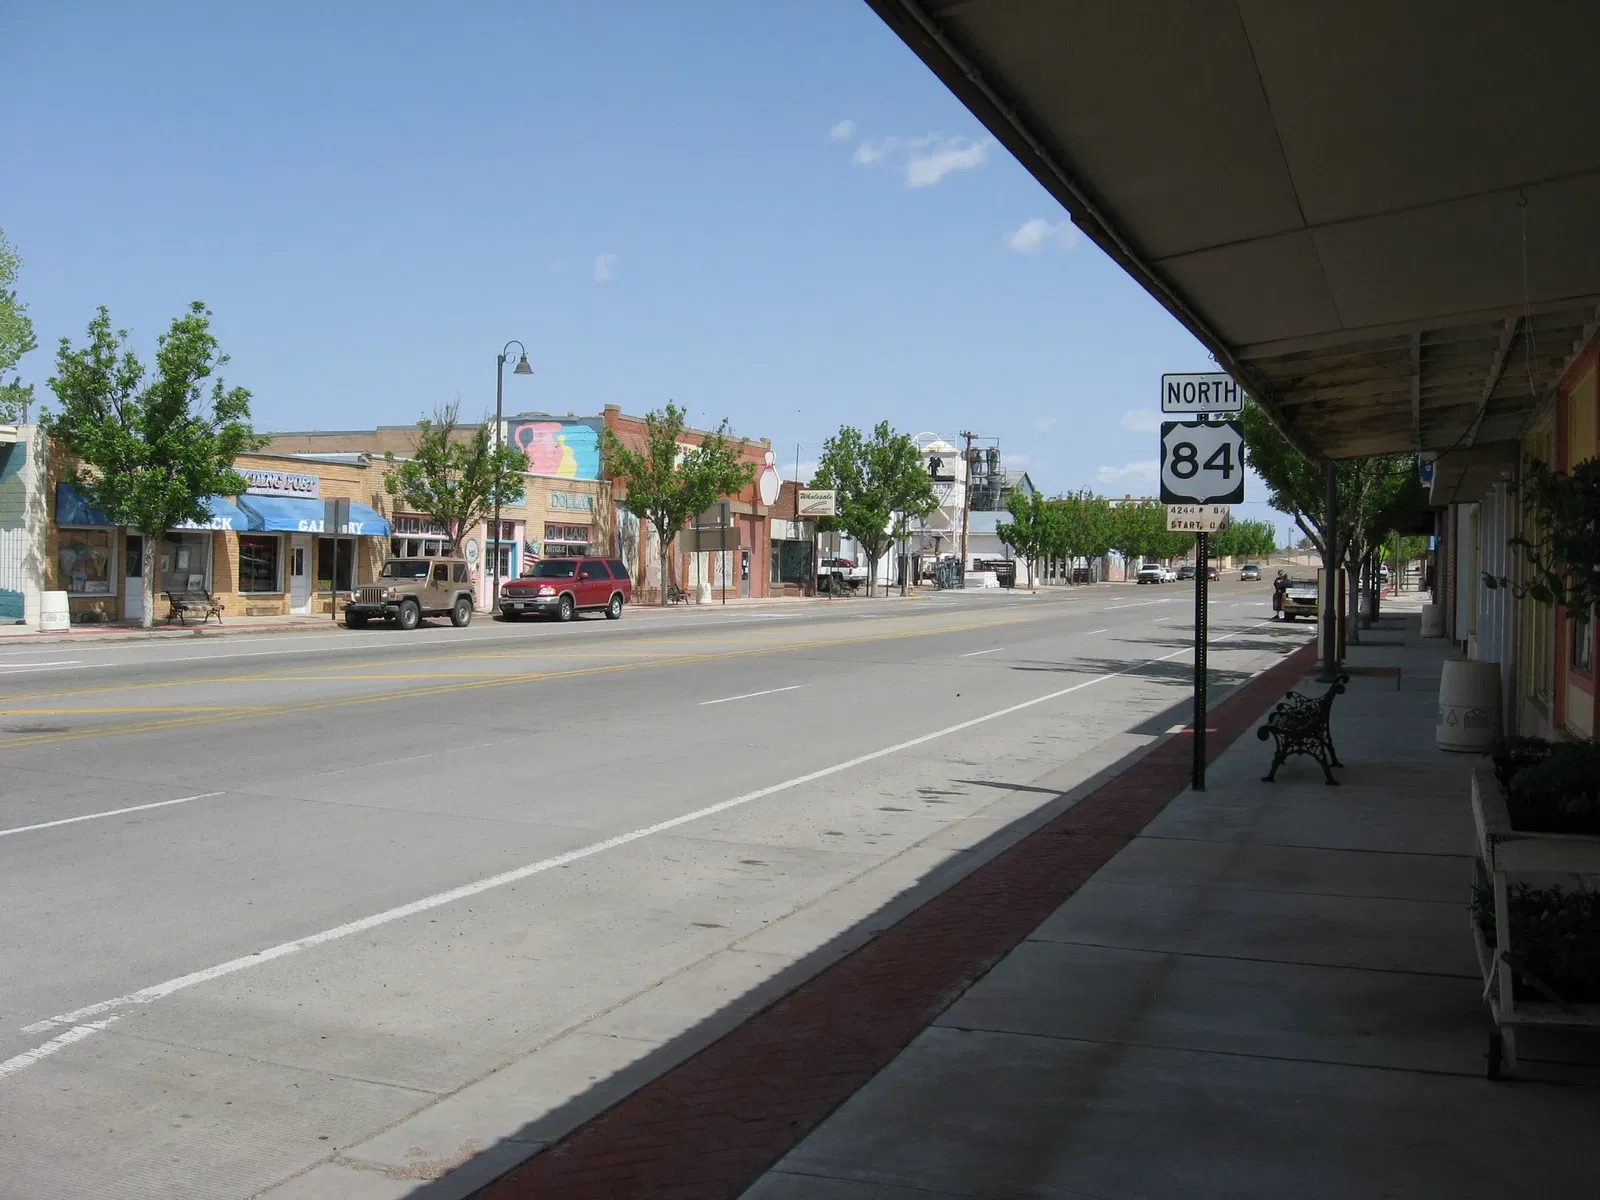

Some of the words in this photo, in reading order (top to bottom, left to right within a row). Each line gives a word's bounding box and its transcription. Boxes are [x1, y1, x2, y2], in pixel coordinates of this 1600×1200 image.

[1168, 381, 1237, 403] NORTH
[1170, 441, 1234, 480] 84
[284, 474, 316, 492] POST
[551, 492, 594, 509] DOLLAR
[800, 492, 833, 500] Wholesale
[1170, 506, 1195, 514] 4244
[298, 519, 364, 535] GARY
